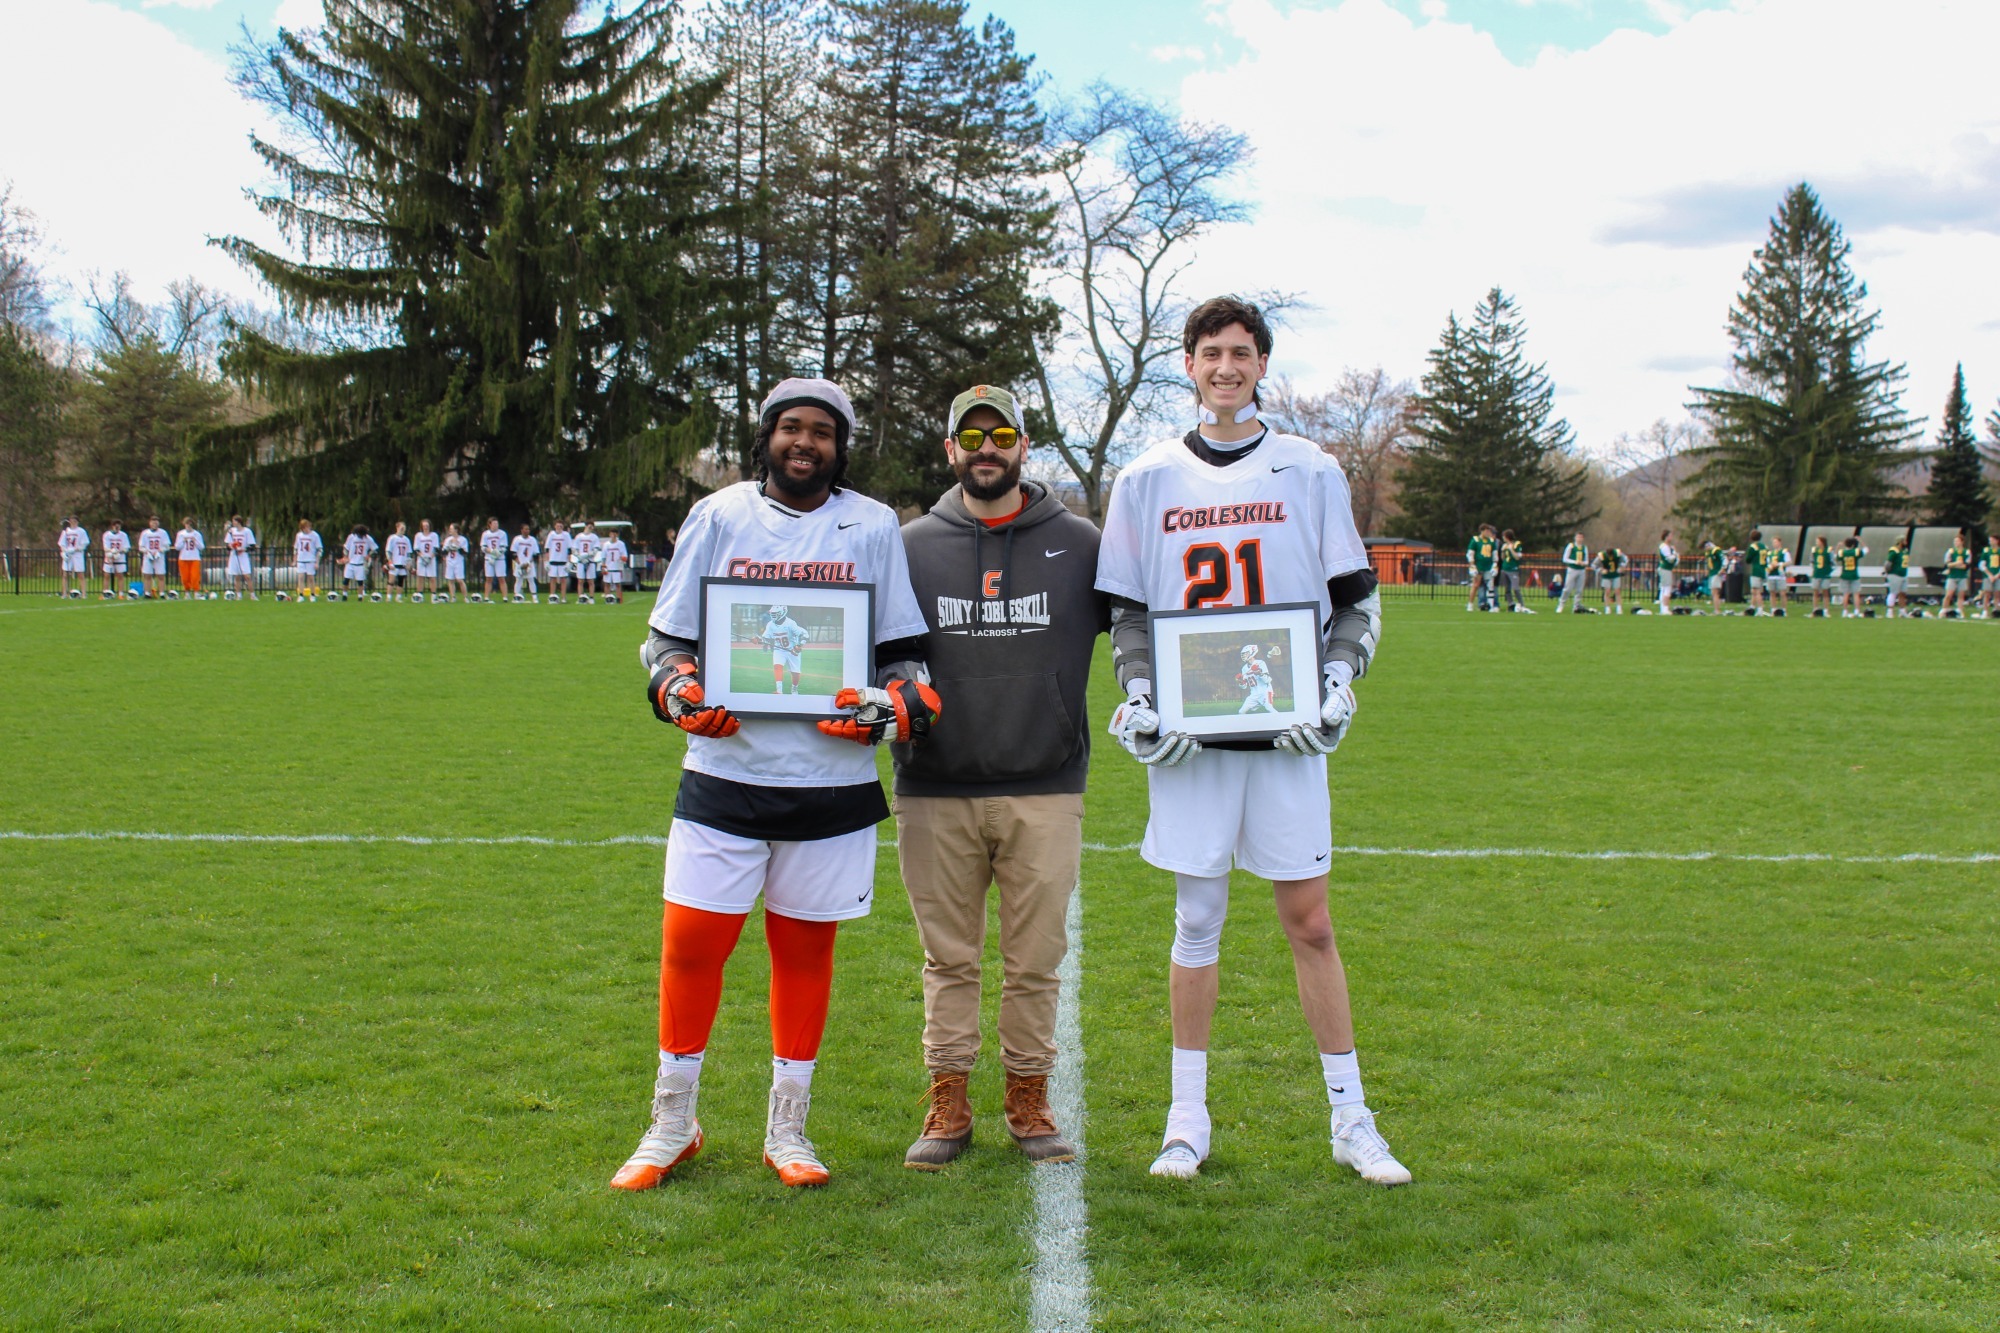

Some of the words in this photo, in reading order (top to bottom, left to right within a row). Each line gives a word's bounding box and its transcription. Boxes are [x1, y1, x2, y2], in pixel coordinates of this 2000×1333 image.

[975, 385, 987, 398] C
[1162, 501, 1288, 534] COBLESKILL
[300, 541, 310, 552] 14
[424, 543, 430, 553] 9
[555, 543, 562, 552] 3
[523, 548, 529, 558] 4
[727, 557, 857, 583] COBLESKILL
[1609, 561, 1616, 572] 3
[1183, 538, 1265, 609] 21
[982, 569, 1003, 599] C
[937, 596, 974, 628] SUNY
[971, 628, 1018, 637] LACROSSE
